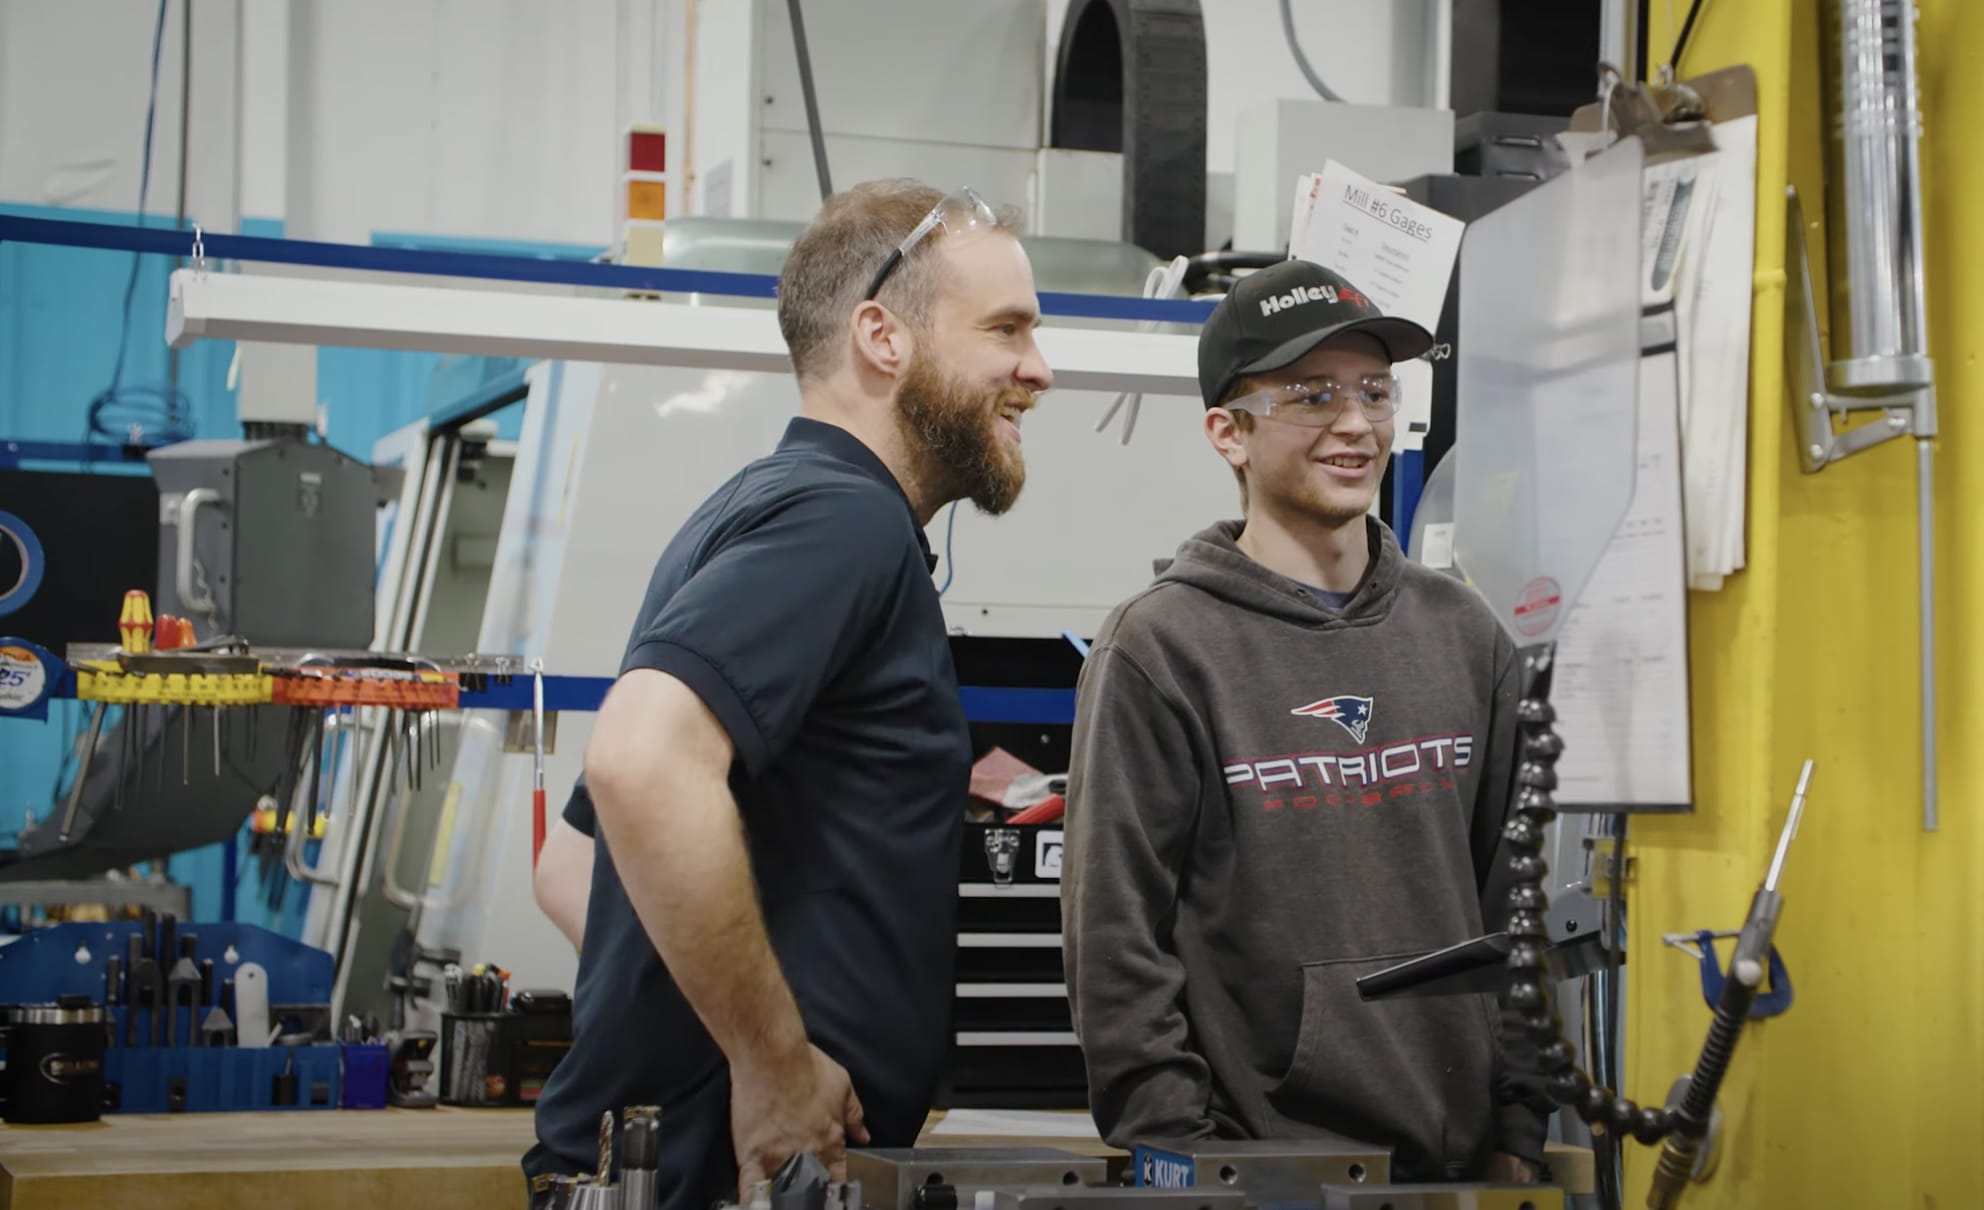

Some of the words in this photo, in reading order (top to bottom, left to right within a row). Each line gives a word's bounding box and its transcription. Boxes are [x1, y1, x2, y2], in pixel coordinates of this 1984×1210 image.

[1344, 184, 1369, 208] Mill
[1371, 197, 1388, 218] #6
[1390, 208, 1433, 239] Gages
[1259, 285, 1338, 317] Holley
[1223, 733, 1473, 791] PATRIOTS
[1263, 776, 1456, 811] FOOBALL
[1155, 1158, 1190, 1188] KURT
